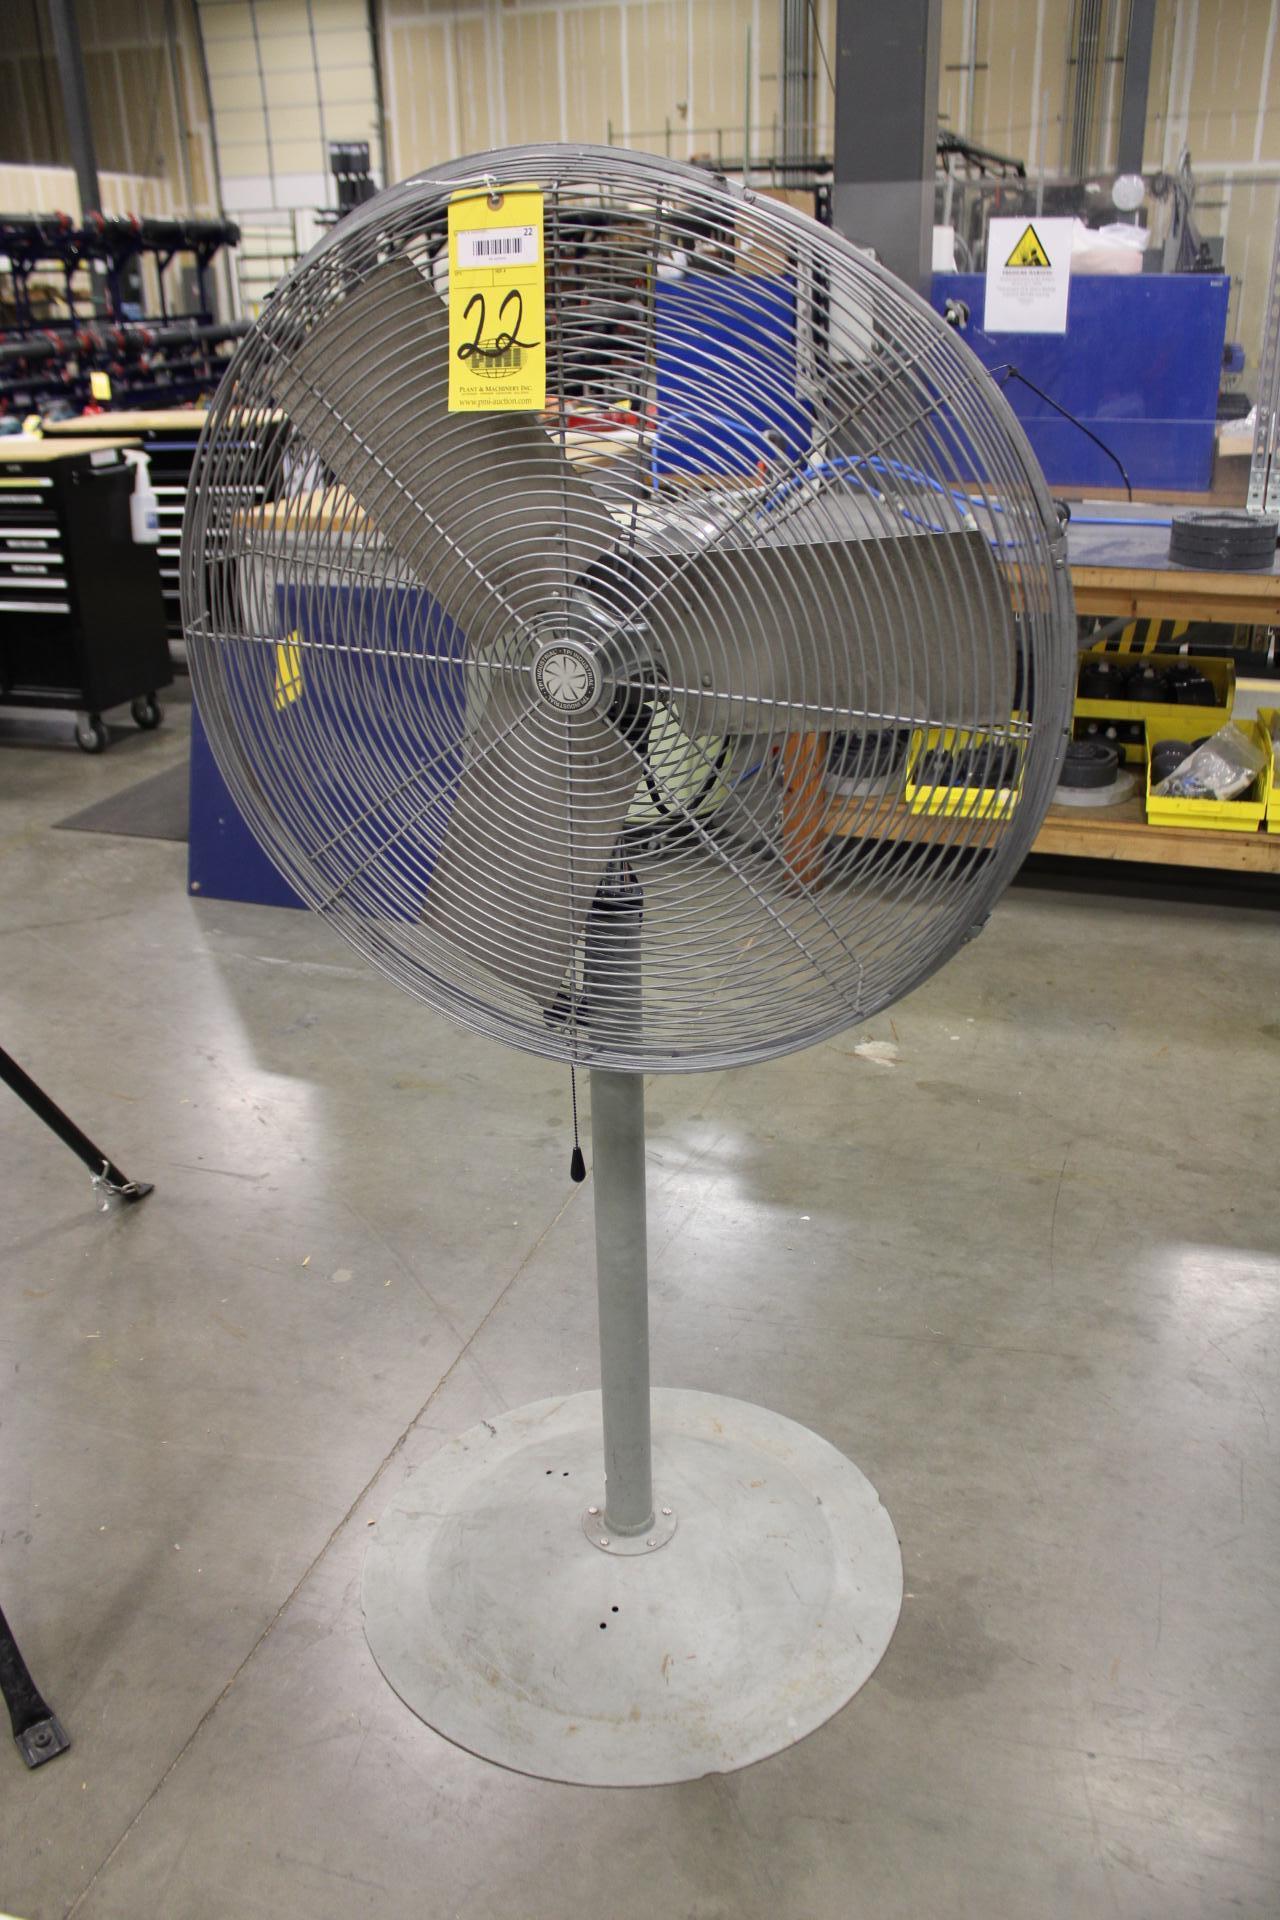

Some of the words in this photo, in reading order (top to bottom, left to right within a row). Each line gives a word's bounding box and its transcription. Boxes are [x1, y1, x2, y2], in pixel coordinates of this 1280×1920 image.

[523, 228, 533, 236] 22
[457, 289, 540, 360] 22
[485, 384, 519, 392] MACHINERY
[459, 397, 533, 408] www.pmi-auction.com
